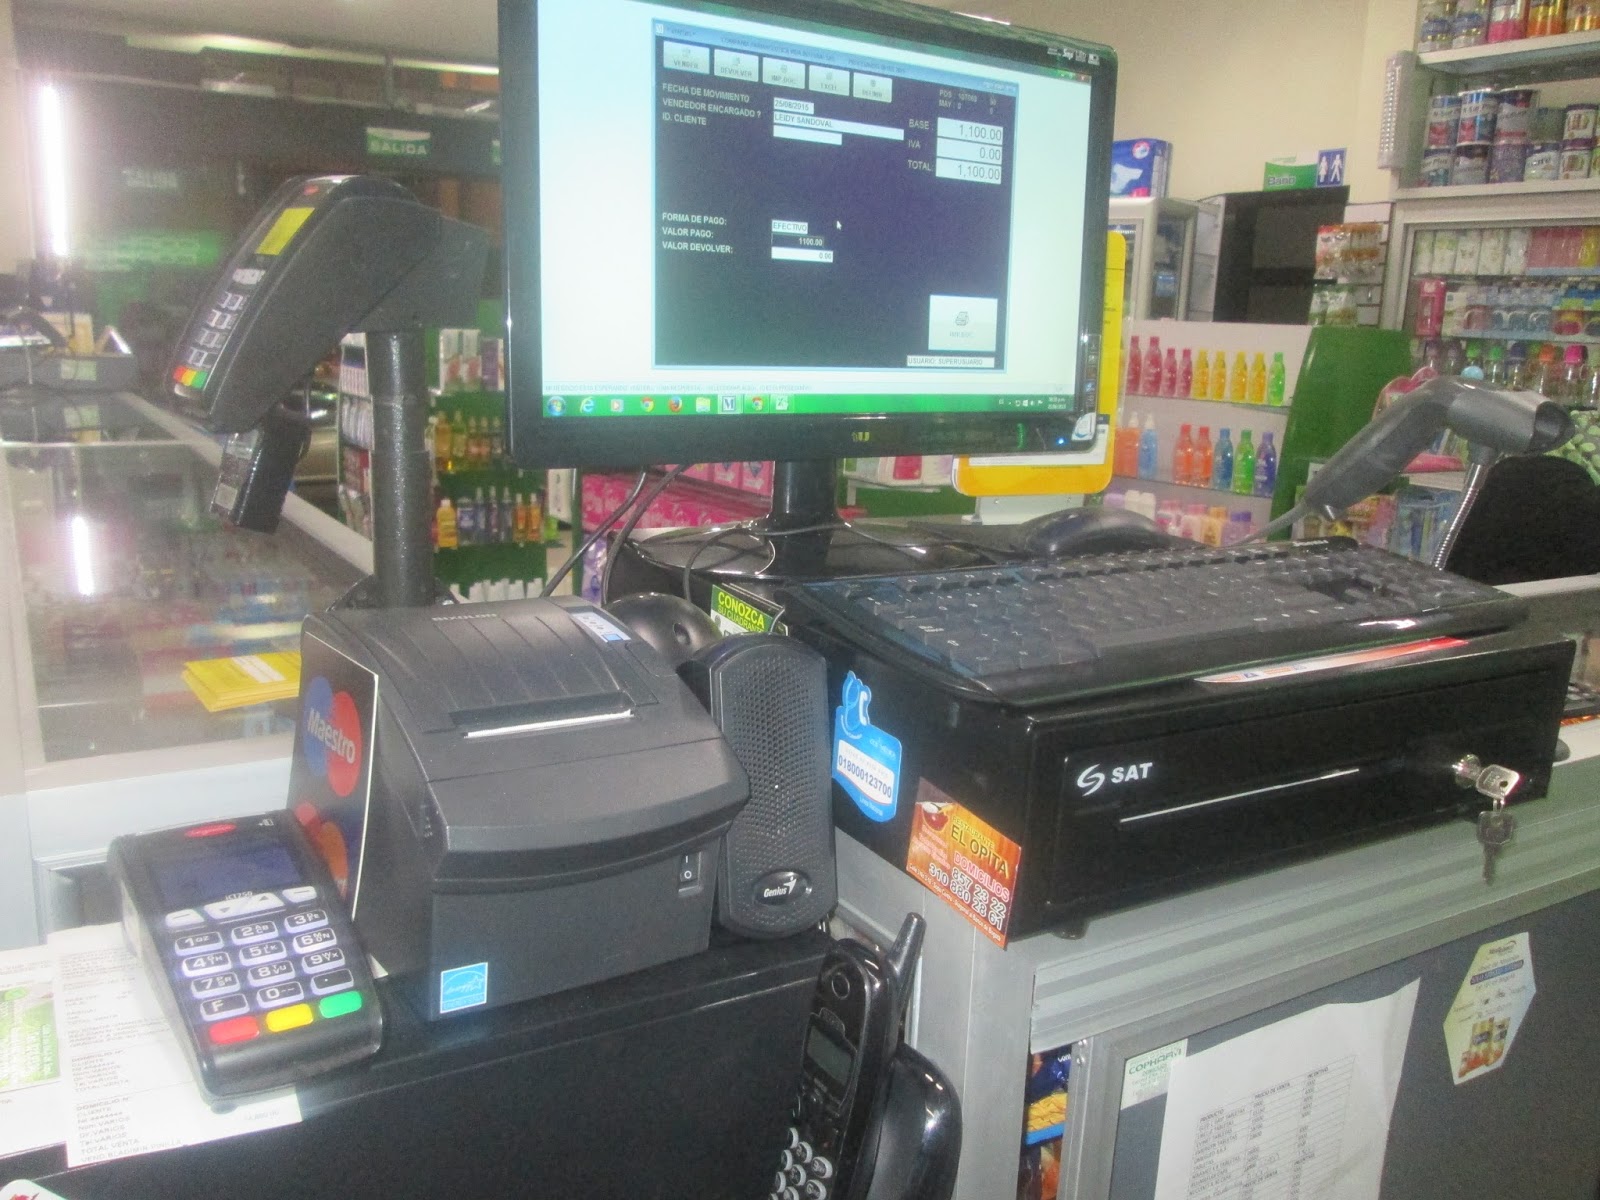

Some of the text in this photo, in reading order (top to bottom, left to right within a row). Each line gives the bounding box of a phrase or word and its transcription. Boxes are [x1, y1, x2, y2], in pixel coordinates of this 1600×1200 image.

[662, 83, 750, 103] FECHA DE MOVIMIENTO
[662, 98, 707, 111] VENDEDOR
[707, 105, 755, 118] ENCARGADO
[774, 100, 809, 111] 25/08/2015
[674, 114, 707, 125] CLIENTE
[774, 115, 833, 128] LEIDY SANDOVAL
[959, 124, 1002, 141] 1,100.00
[908, 139, 1001, 161] IVA 0.00
[957, 164, 1001, 180] 1,100.00
[662, 212, 727, 226] FORMA DE PAGO:
[662, 226, 714, 238] VALOR PAGO:
[773, 221, 807, 232] EFECTIVO
[662, 241, 733, 254] VALOR DEVOLVER:
[938, 357, 983, 366] SUPERUSUARIO
[718, 592, 765, 629] CONOZCA
[307, 708, 356, 764] Maestro
[838, 755, 892, 798] 018000123700
[1111, 762, 1153, 784] SAT
[952, 817, 995, 849] RESTAURANTE
[951, 824, 966, 846] EL
[969, 838, 1010, 880] OPITA
[954, 851, 1010, 901] DOMICILIOS
[763, 886, 787, 898] Genius
[928, 863, 949, 886] 310
[950, 881, 970, 904] 880
[971, 897, 987, 917] 28
[988, 910, 1002, 931] 61
[951, 867, 972, 889] 857
[990, 896, 1006, 918] 22
[294, 915, 306, 924] 3
[240, 927, 255, 936] 2
[185, 937, 195, 947] 1
[301, 935, 314, 945] 6
[249, 947, 262, 957] 5
[193, 957, 208, 968] 4
[310, 955, 322, 965] 9
[257, 967, 271, 977] 8
[201, 979, 215, 989] 7
[212, 1001, 224, 1012] F
